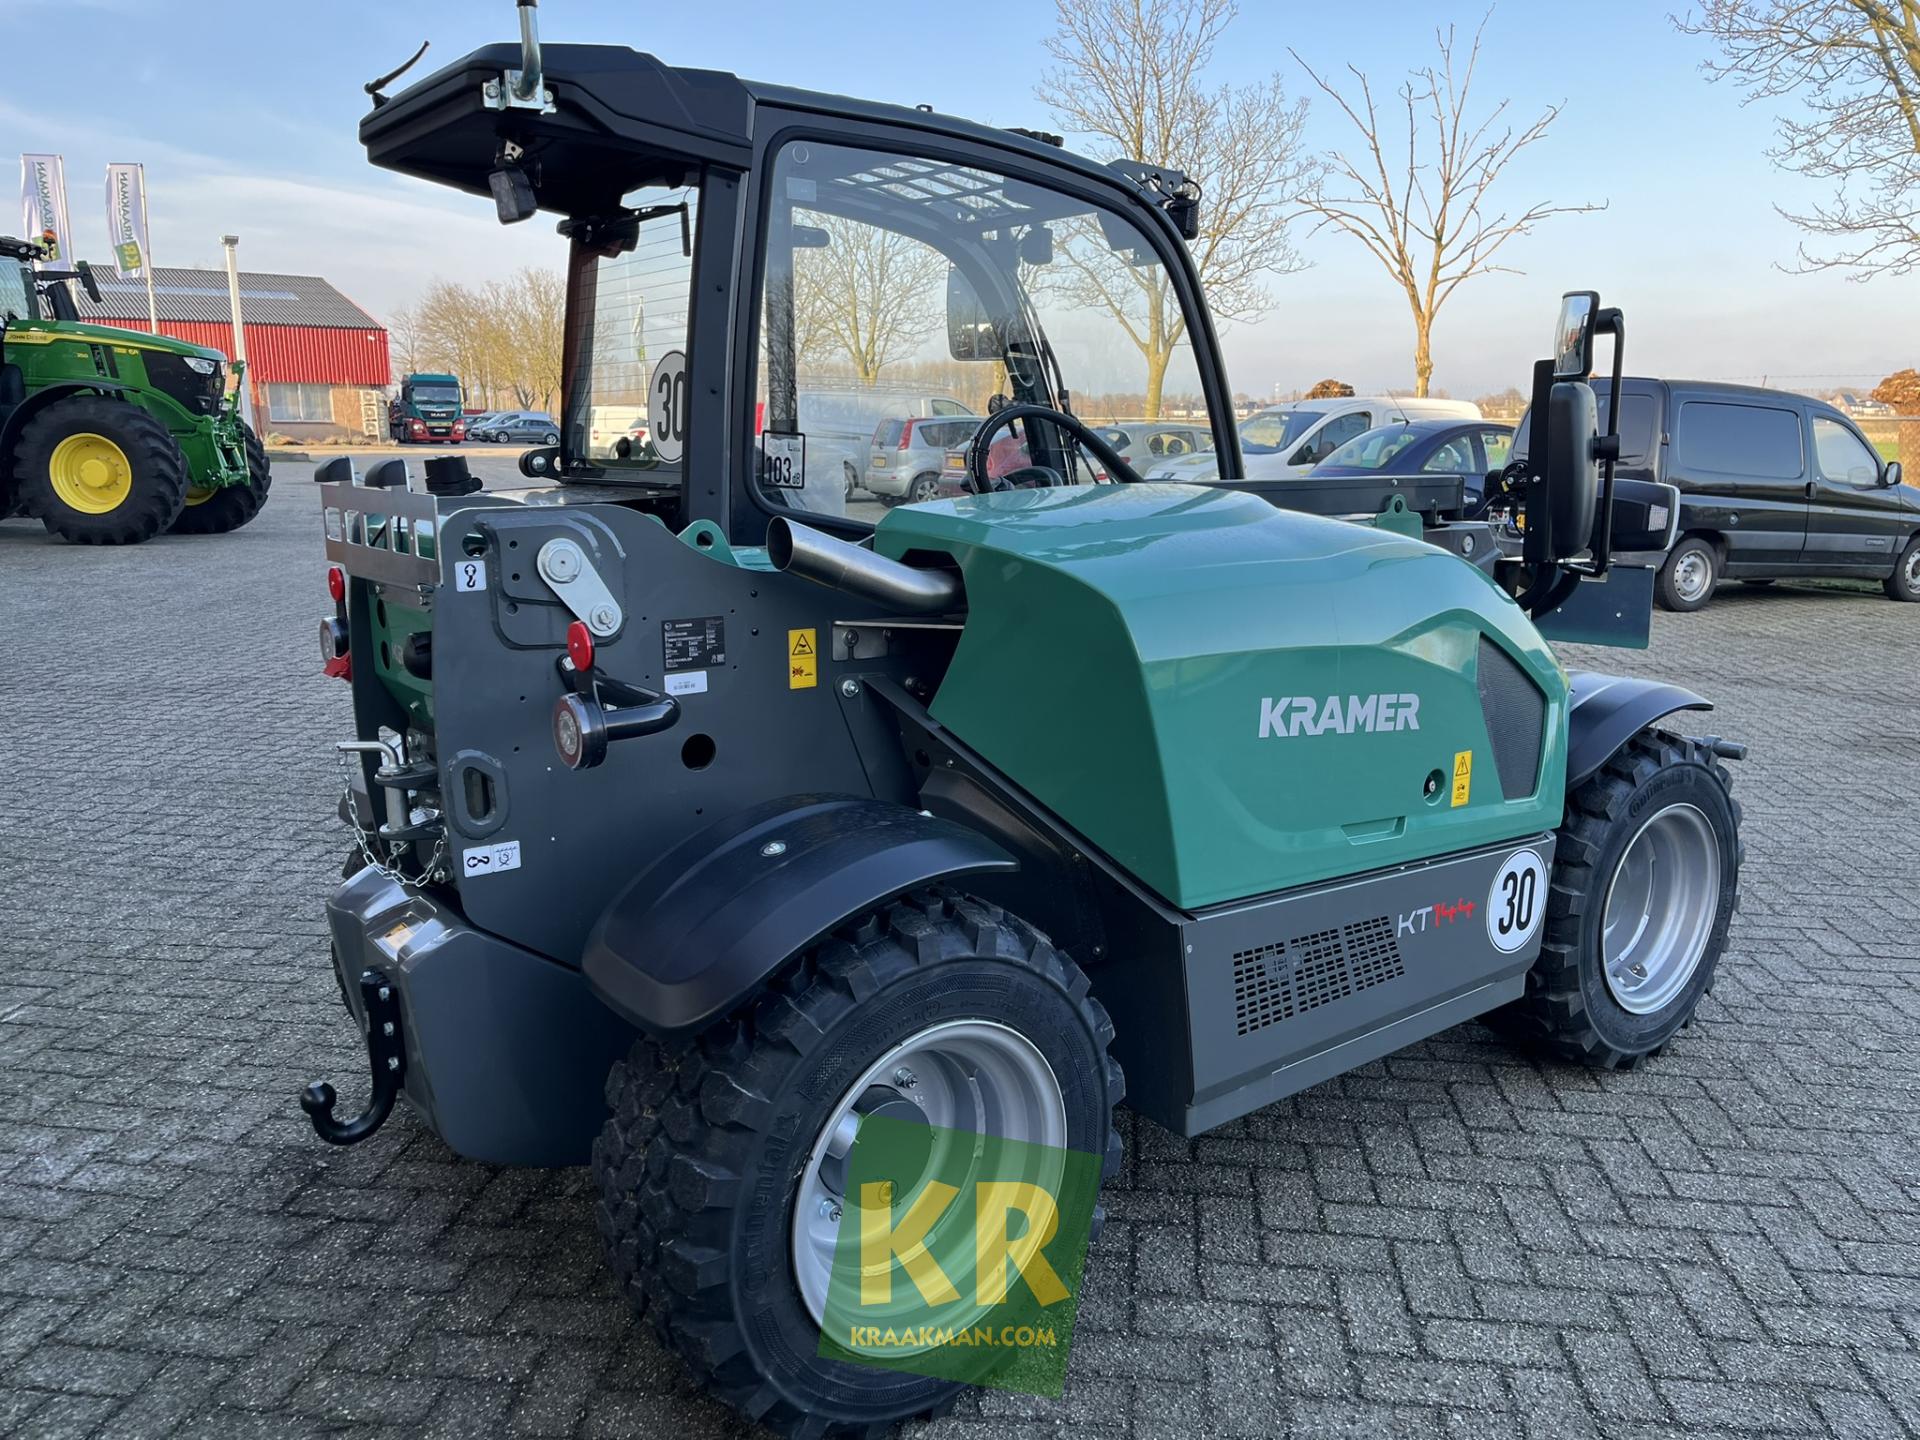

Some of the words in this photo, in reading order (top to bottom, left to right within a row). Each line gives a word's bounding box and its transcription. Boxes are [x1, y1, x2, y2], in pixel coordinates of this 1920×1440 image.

[657, 371, 685, 441] 30
[765, 456, 792, 484] 103
[1258, 693, 1420, 738] KRAMER
[1498, 867, 1536, 935] 30
